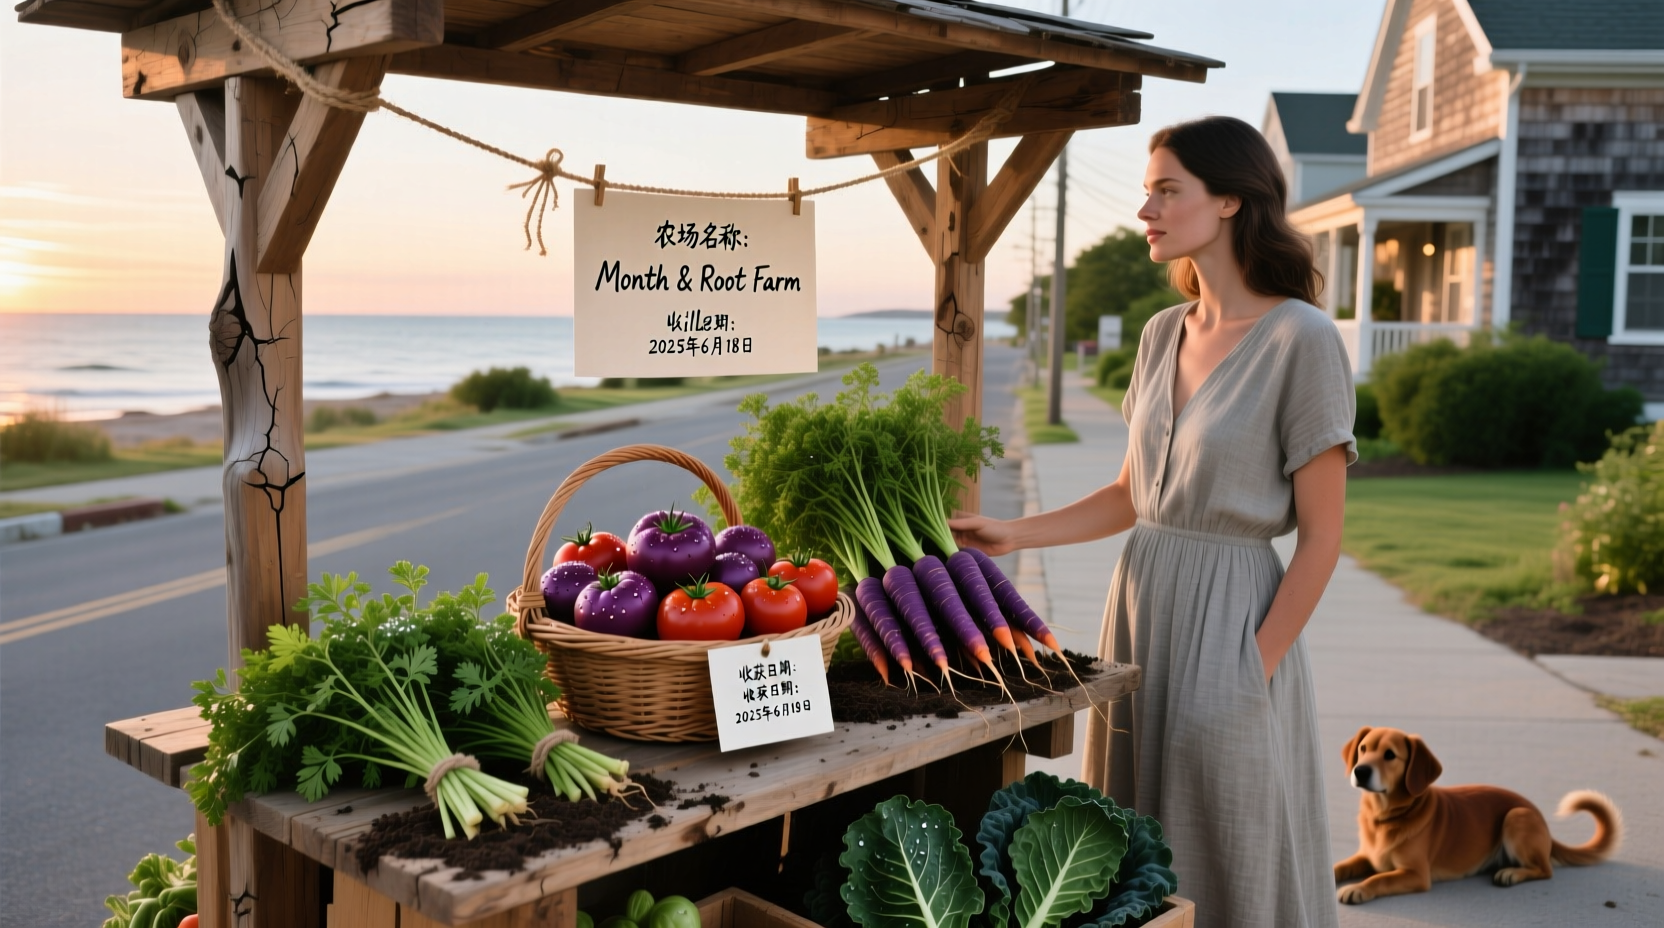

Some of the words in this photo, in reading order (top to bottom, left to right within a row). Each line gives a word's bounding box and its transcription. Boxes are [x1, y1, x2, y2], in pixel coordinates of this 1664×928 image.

[655, 220, 748, 251] 农场名称:
[595, 260, 669, 292] Month
[677, 264, 693, 292] &
[700, 264, 746, 292] Root
[753, 264, 801, 292] Farm
[649, 336, 752, 357] 2025年6月18日
[735, 699, 811, 724] 2025年6月19日
